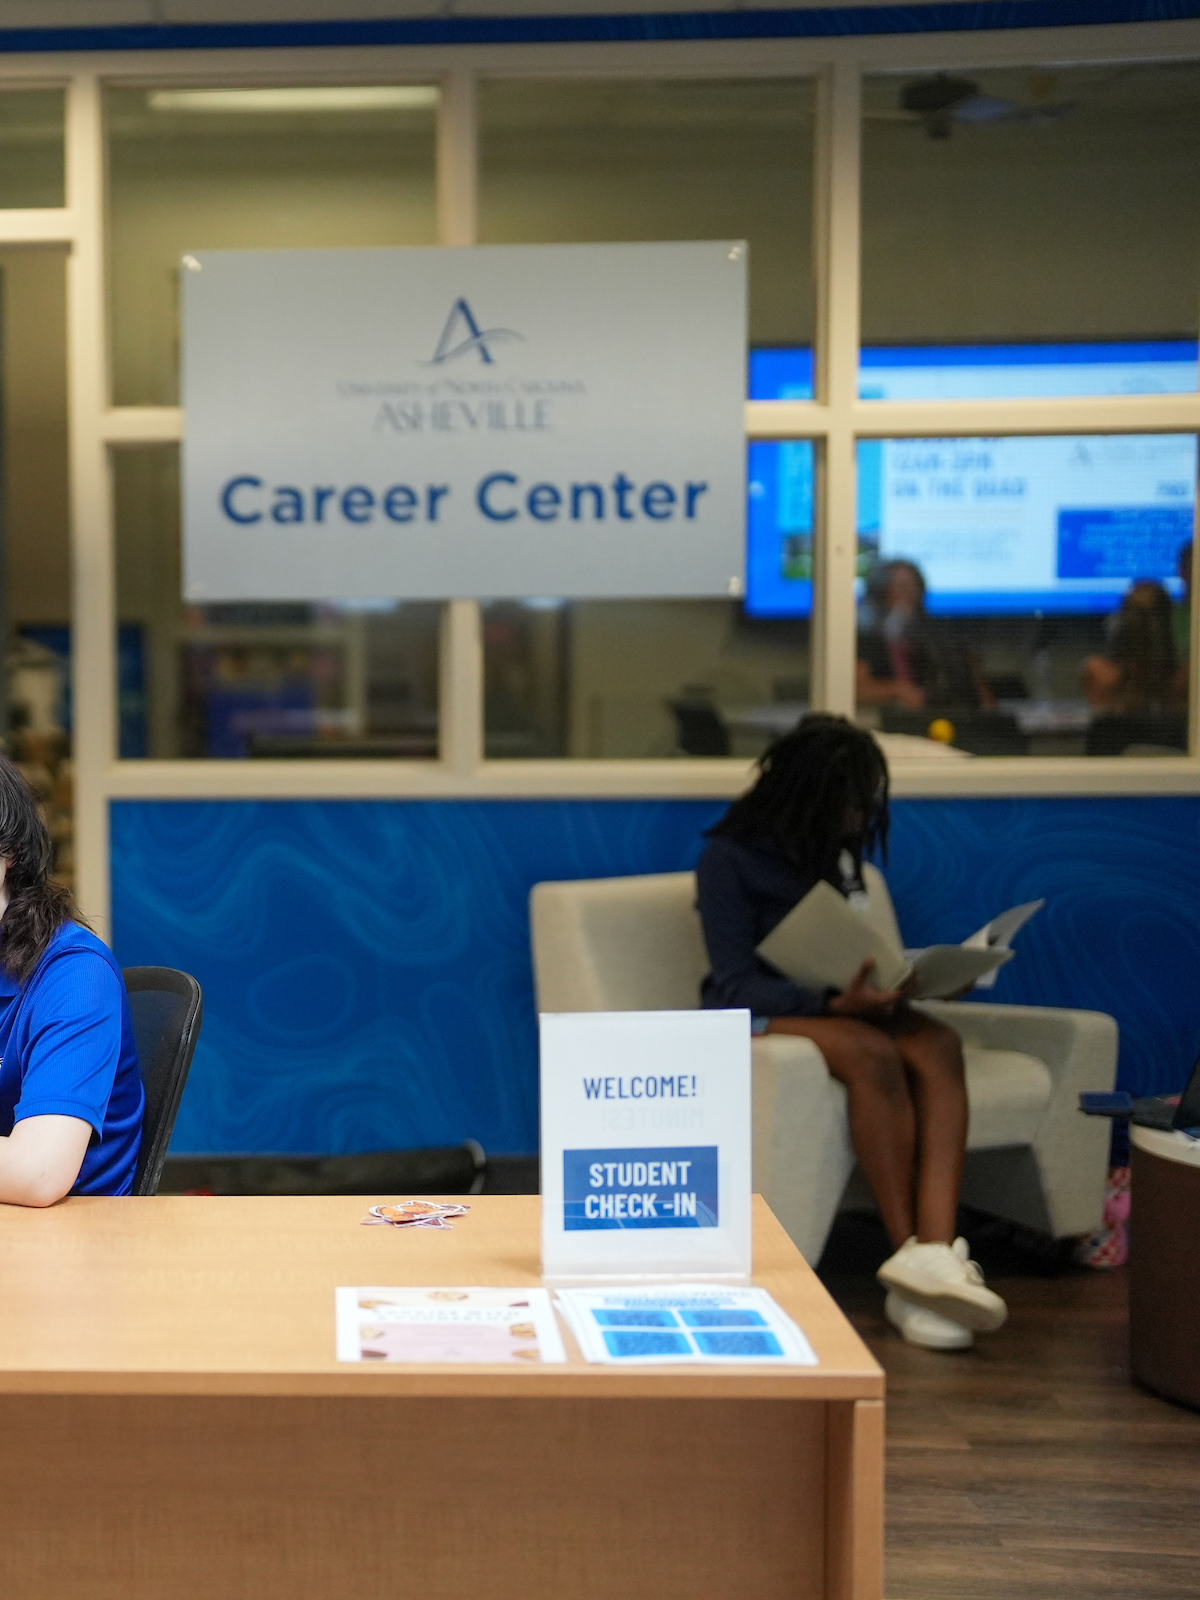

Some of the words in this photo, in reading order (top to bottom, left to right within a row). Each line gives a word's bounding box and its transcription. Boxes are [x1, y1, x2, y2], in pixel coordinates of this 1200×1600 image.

[372, 397, 556, 433] ASHEVILLE
[220, 475, 449, 525] Career
[476, 471, 708, 522] Center
[583, 1075, 697, 1100] WELCOME!
[588, 1161, 692, 1187] STUDENT
[584, 1194, 657, 1219] CHECK
[663, 1192, 697, 1218] -IN
